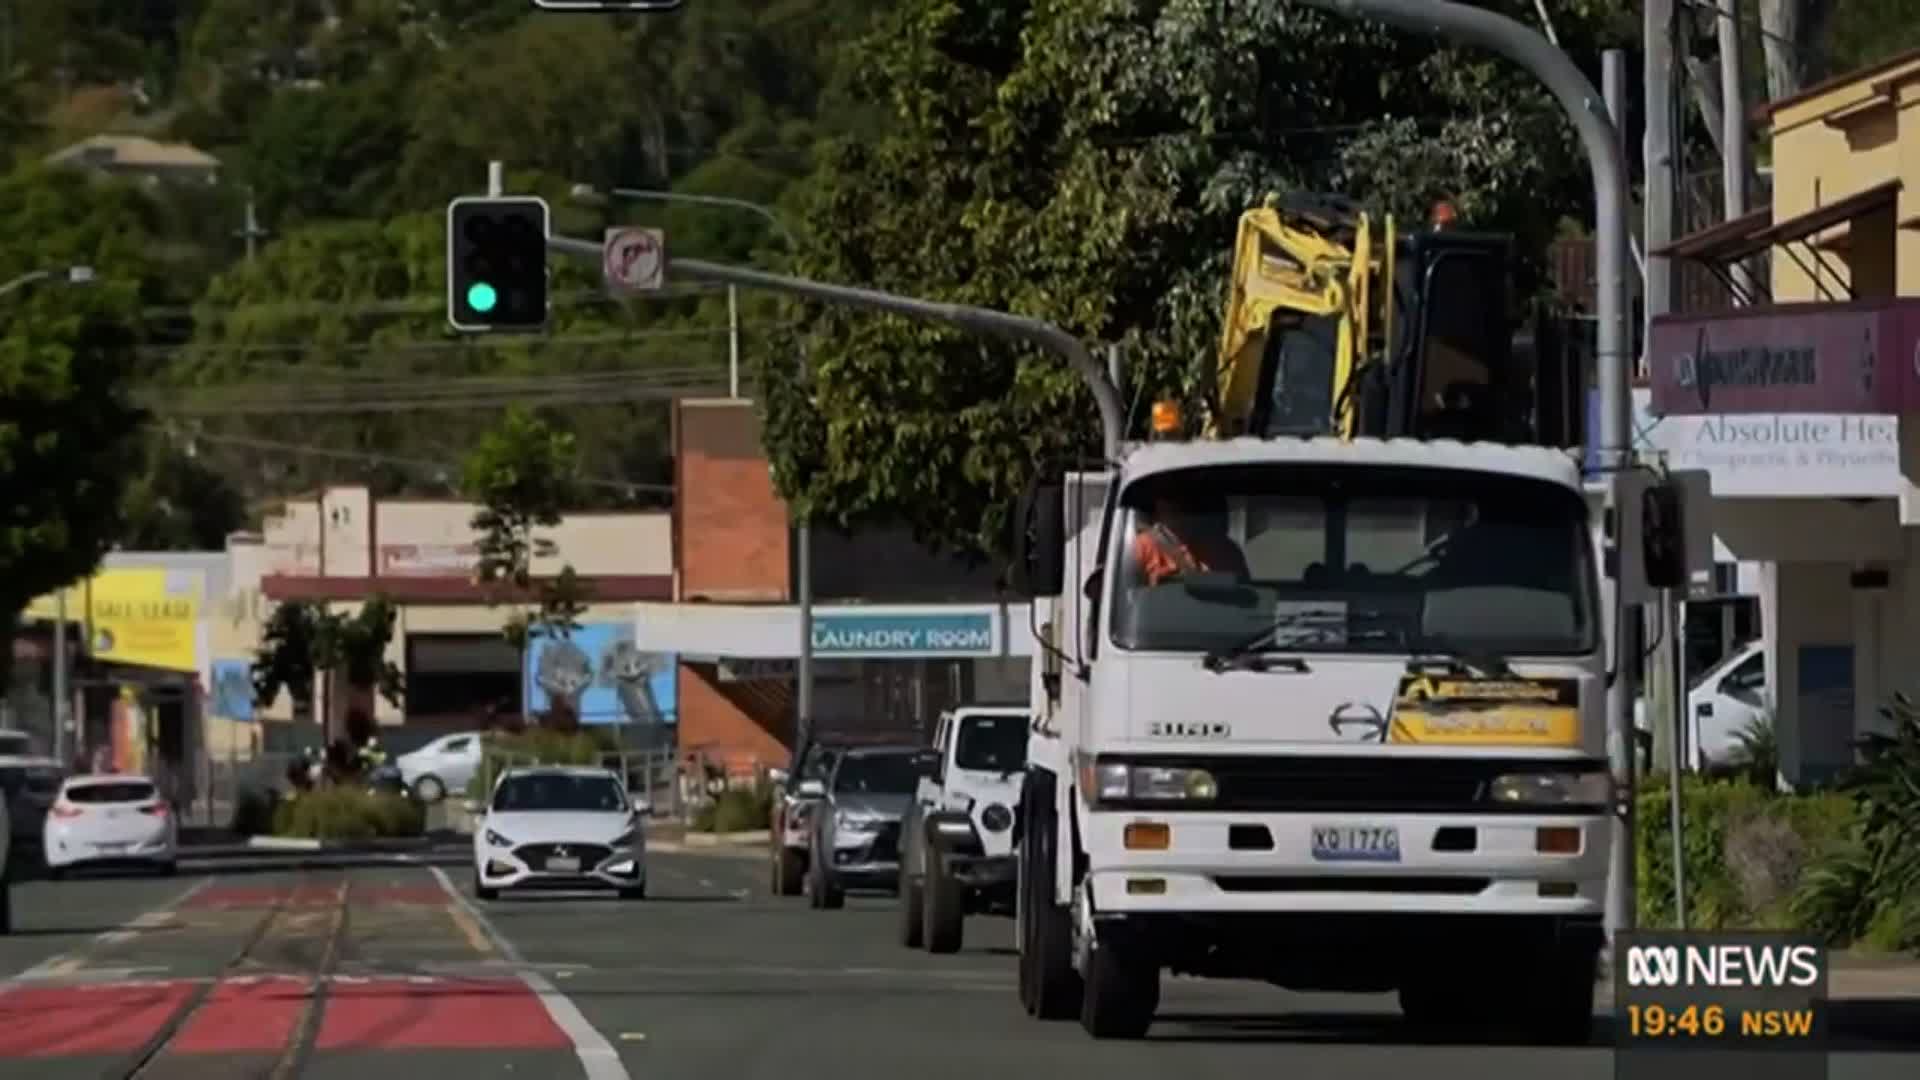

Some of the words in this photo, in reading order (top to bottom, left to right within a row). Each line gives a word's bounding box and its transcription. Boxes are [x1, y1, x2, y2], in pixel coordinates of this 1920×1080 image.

[1696, 416, 1830, 444] Absolute
[811, 630, 920, 648] LAUNDRY
[926, 629, 990, 648] ROOM
